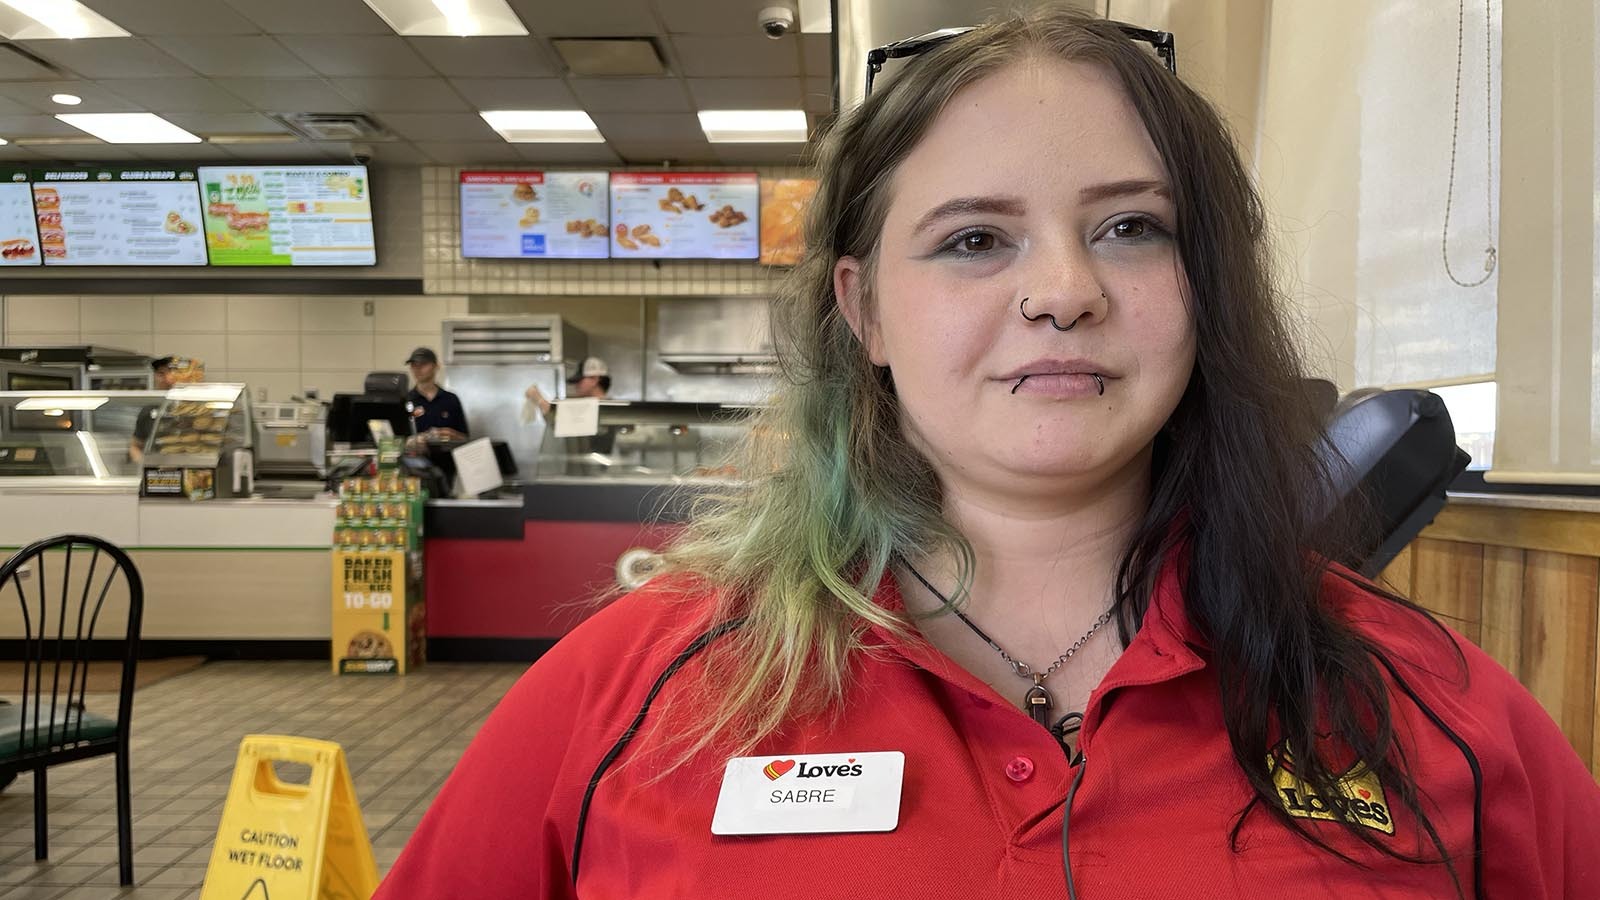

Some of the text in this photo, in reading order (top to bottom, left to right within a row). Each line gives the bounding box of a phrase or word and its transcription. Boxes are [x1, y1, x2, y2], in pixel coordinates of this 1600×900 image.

[344, 558, 392, 568] BAKED
[344, 569, 392, 583] FRESH
[344, 592, 393, 608] TO-GO
[770, 789, 836, 803] SABRE
[241, 829, 299, 849] CAUTION
[229, 850, 303, 871] WET FLOOR
